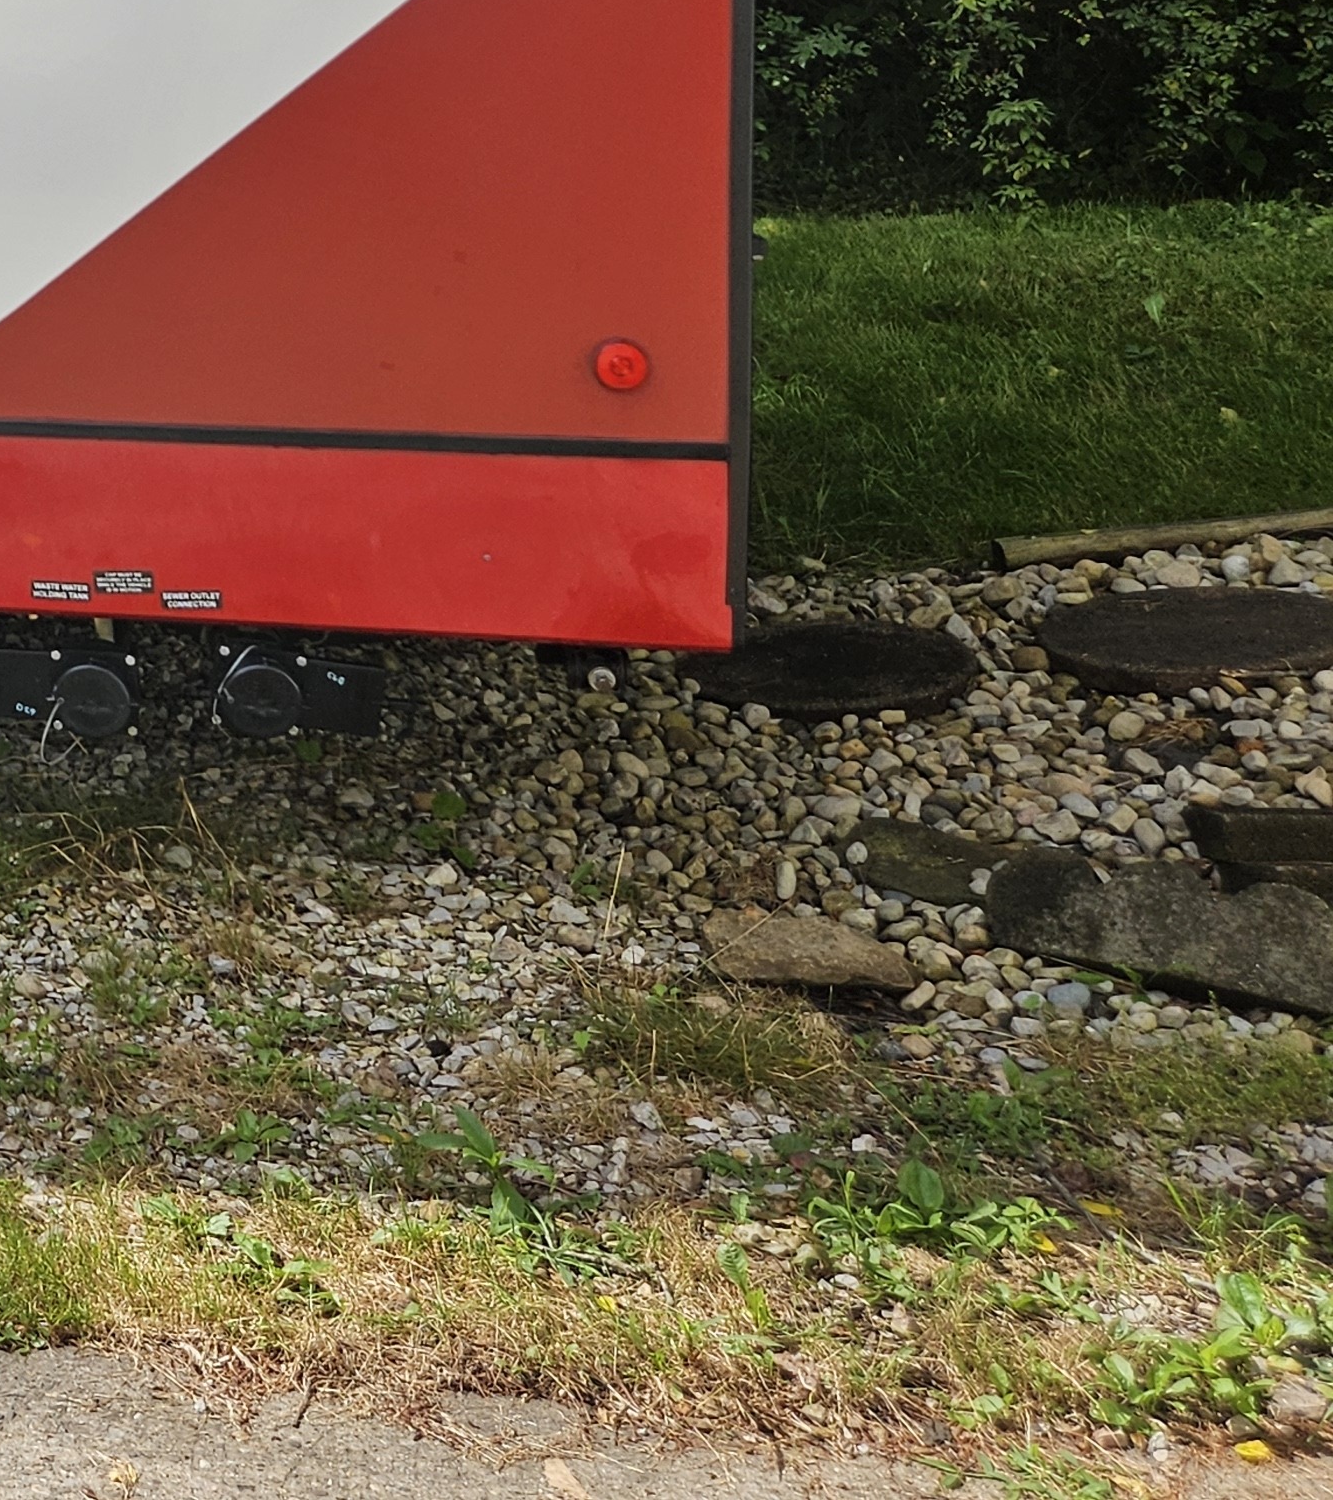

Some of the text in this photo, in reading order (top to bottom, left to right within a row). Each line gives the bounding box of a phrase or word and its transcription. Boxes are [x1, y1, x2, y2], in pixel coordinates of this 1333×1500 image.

[33, 582, 88, 592] WASTE WATER
[33, 590, 89, 600] HOLDING TANK
[163, 591, 220, 600] SEWER OUTLET
[167, 600, 217, 608] CONNECTION
